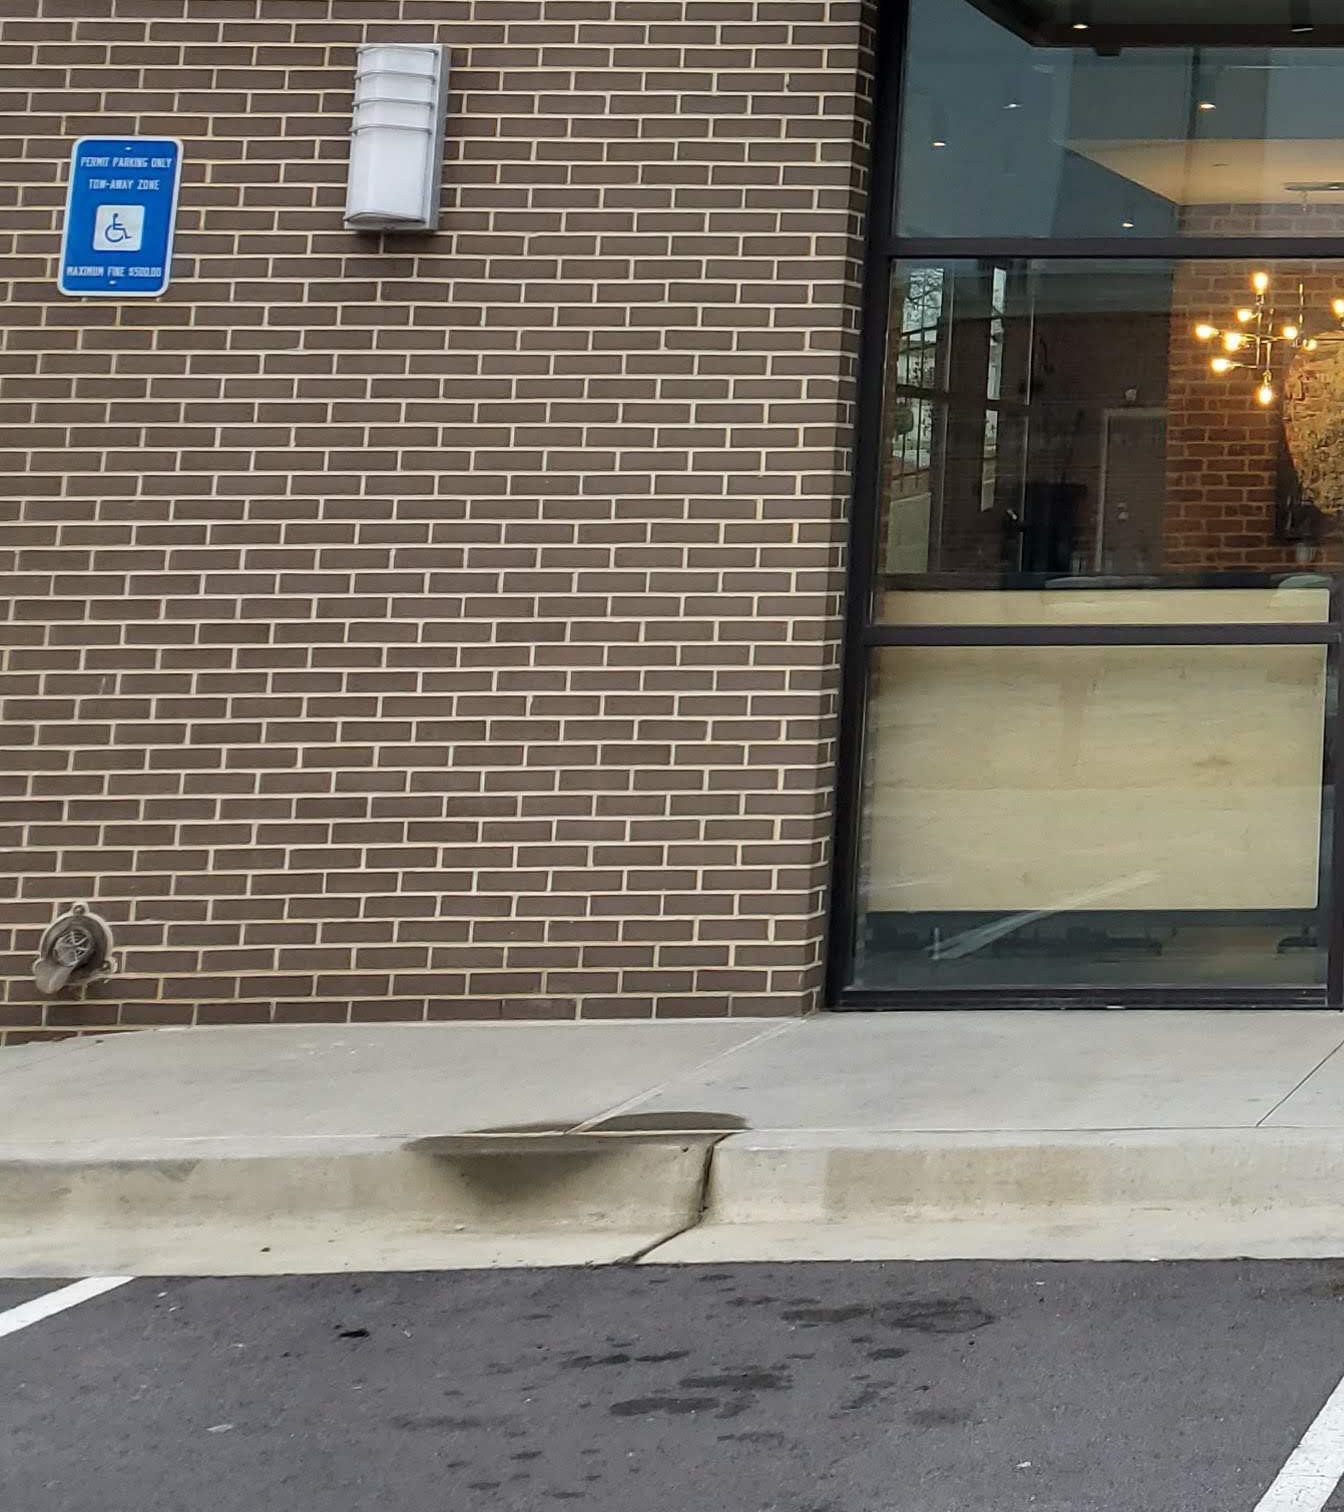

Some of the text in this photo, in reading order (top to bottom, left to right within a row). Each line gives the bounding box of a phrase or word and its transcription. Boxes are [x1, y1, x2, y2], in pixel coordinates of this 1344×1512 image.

[112, 156, 149, 169] PARKING
[150, 157, 173, 169] ONLY
[136, 179, 161, 191] ZONE
